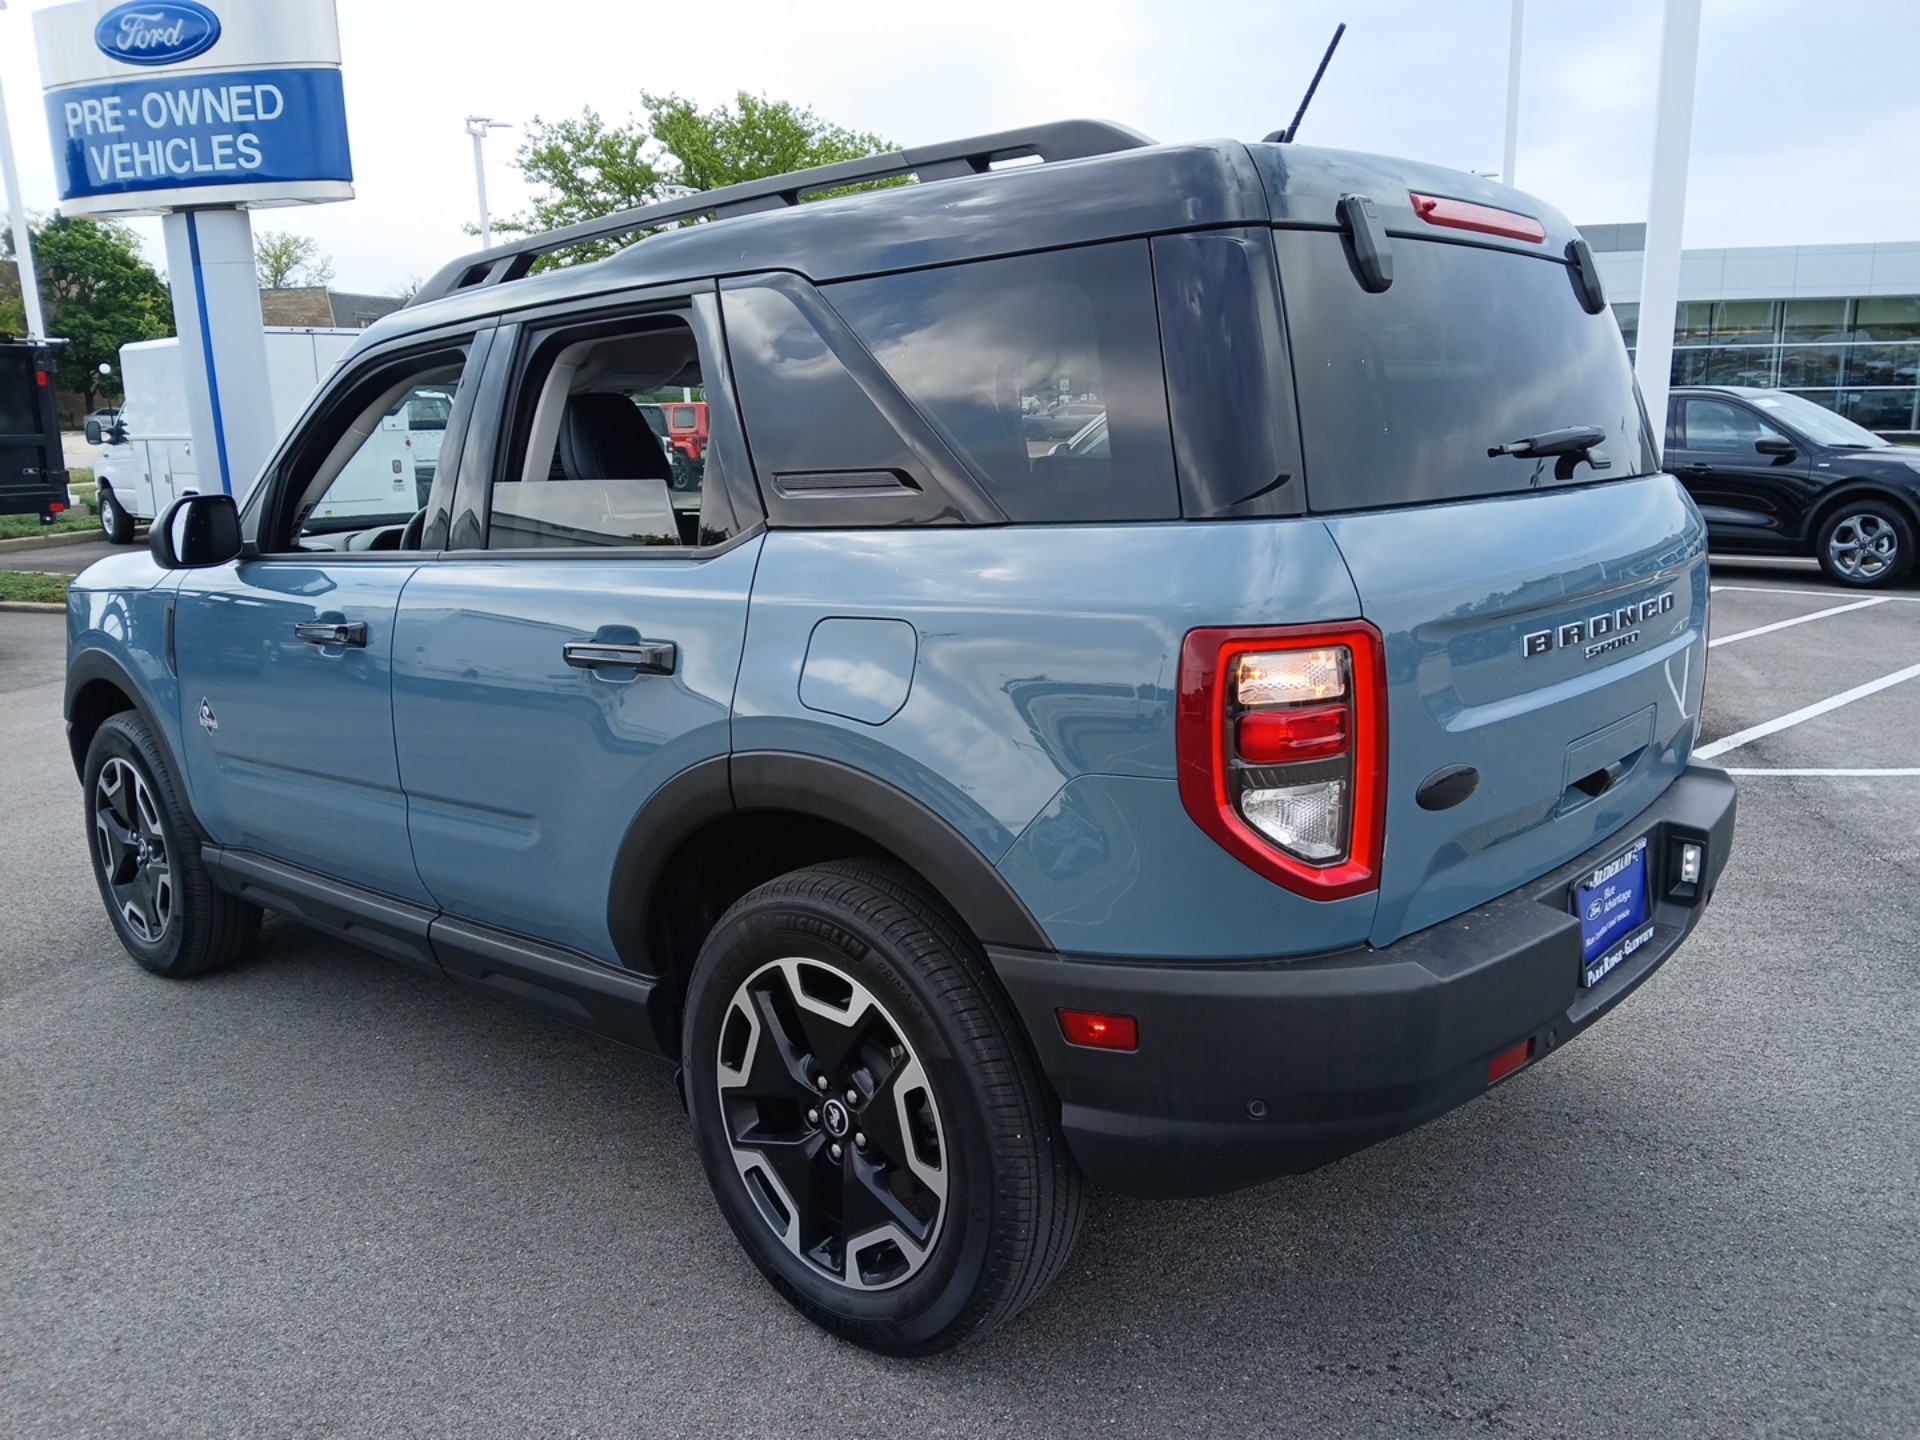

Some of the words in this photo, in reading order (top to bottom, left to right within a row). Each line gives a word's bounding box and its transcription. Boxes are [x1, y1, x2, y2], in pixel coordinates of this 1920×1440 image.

[115, 12, 184, 50] Ford
[64, 84, 284, 138] PRE-OWNED
[90, 132, 263, 181] VEHICLES
[1521, 591, 1675, 659] BRONCO
[1584, 630, 1641, 659] SPORT
[774, 914, 866, 957] MICHELIN
[876, 961, 927, 1021] PRIMACY
